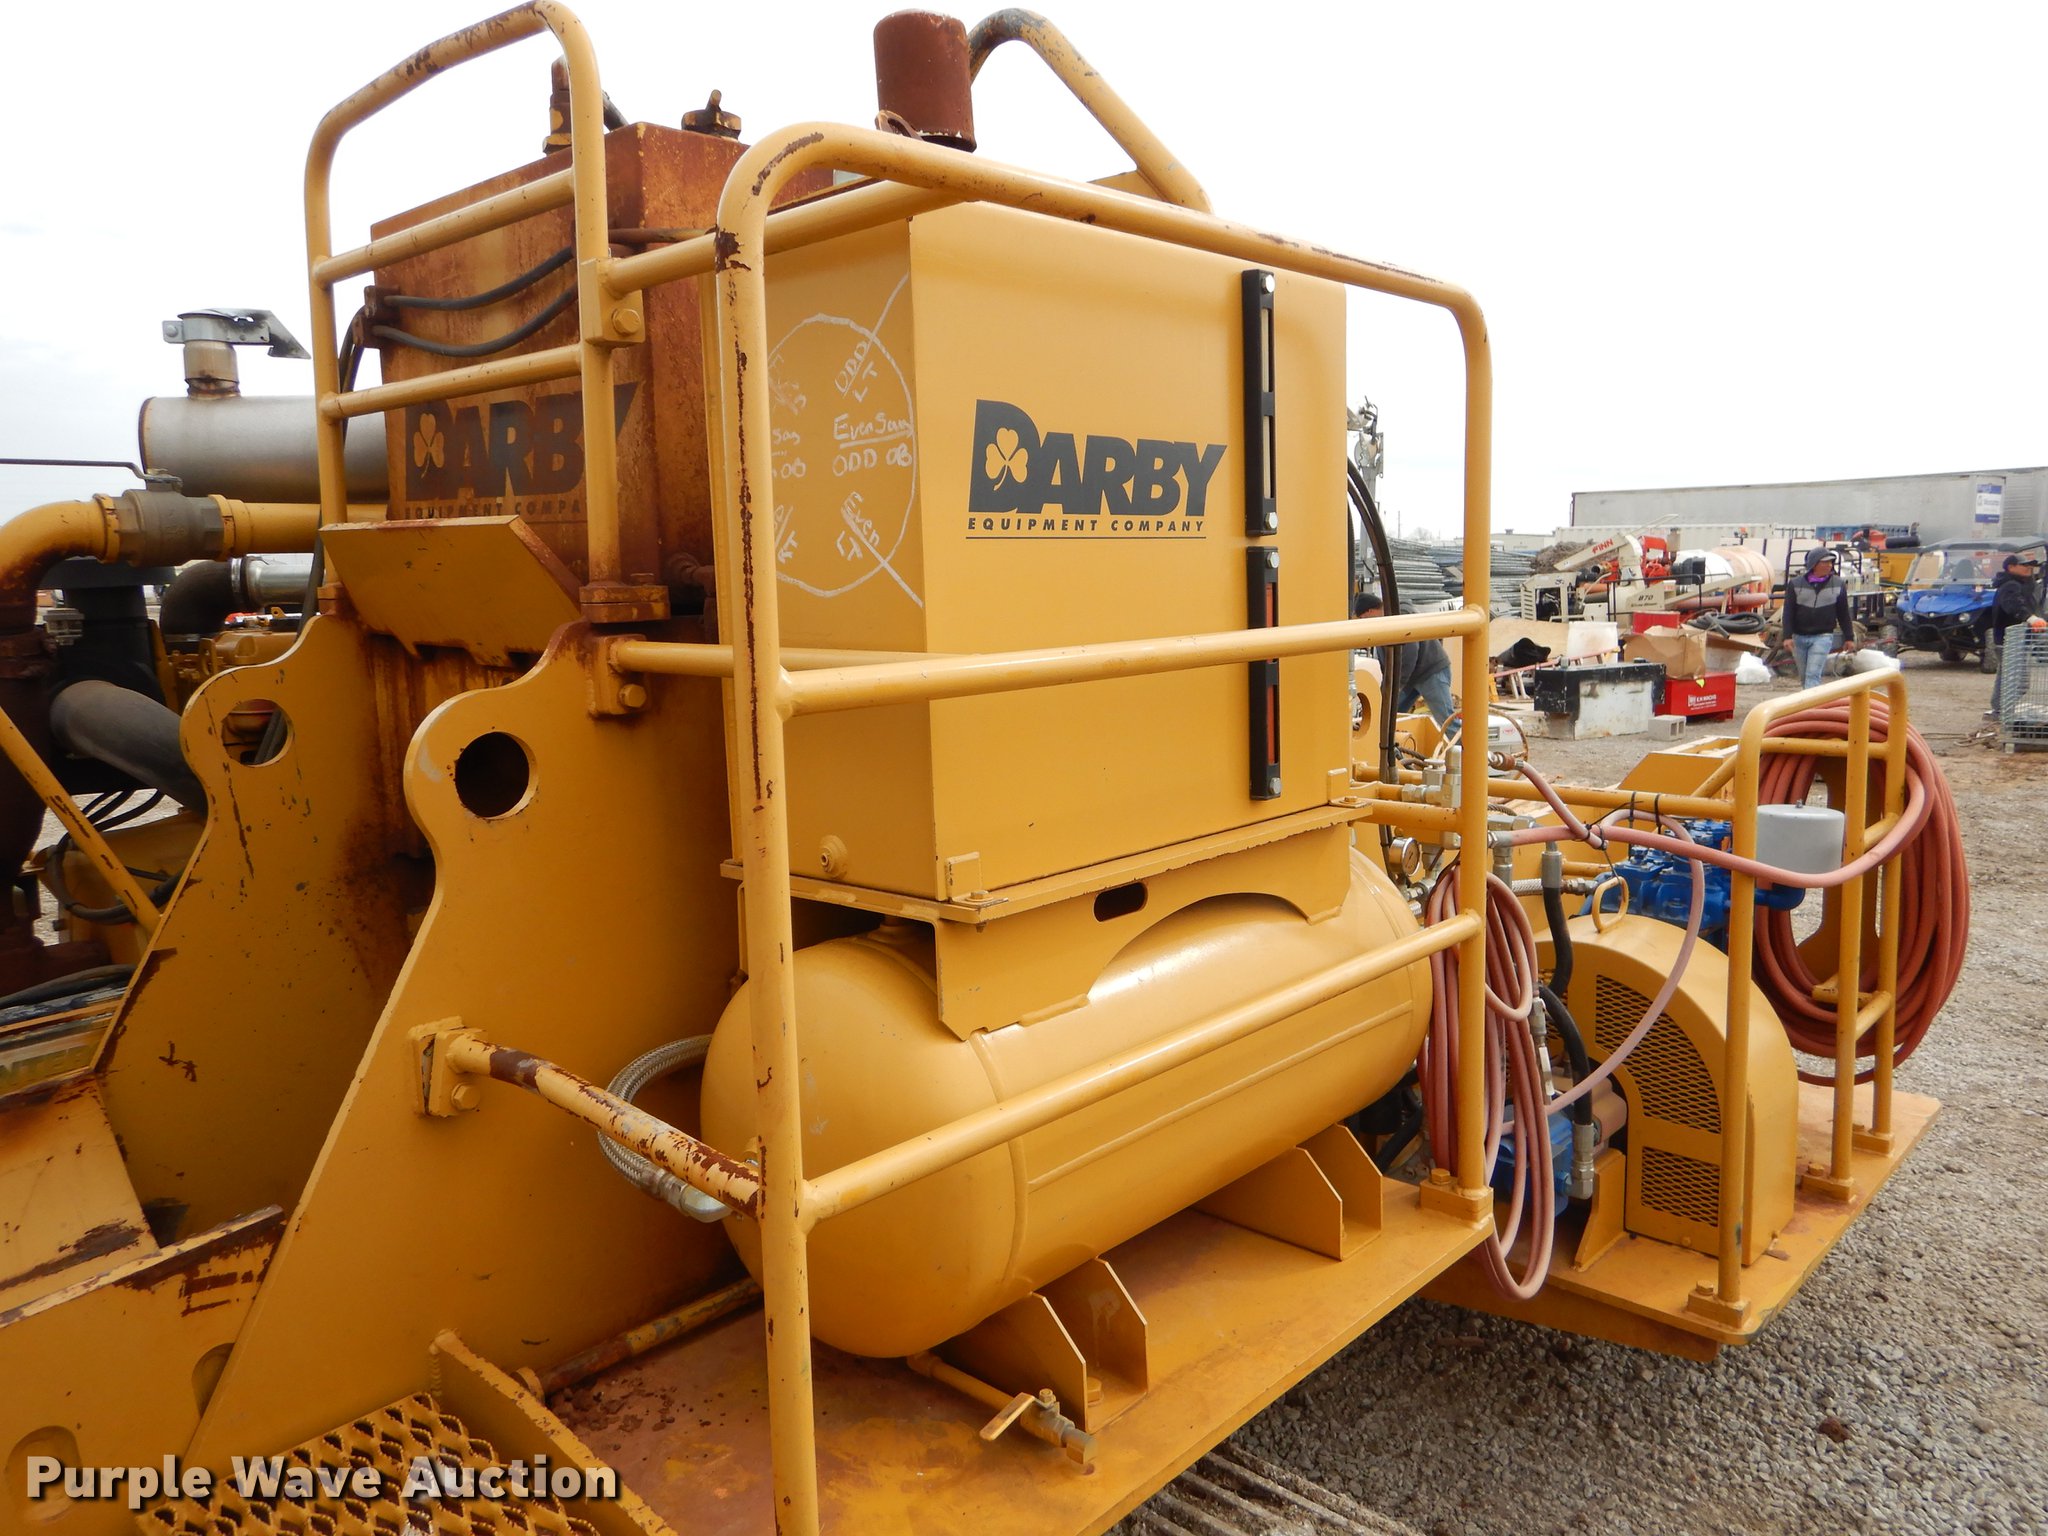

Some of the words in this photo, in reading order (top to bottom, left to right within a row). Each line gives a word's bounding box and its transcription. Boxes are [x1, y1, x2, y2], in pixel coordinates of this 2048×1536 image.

[833, 413, 873, 440] Even
[832, 448, 877, 477] ODD
[968, 399, 1228, 517] DARBY
[968, 517, 1098, 532] EQUIPMENT
[1111, 520, 1204, 533] COMPANY
[1591, 538, 1614, 555] FINN
